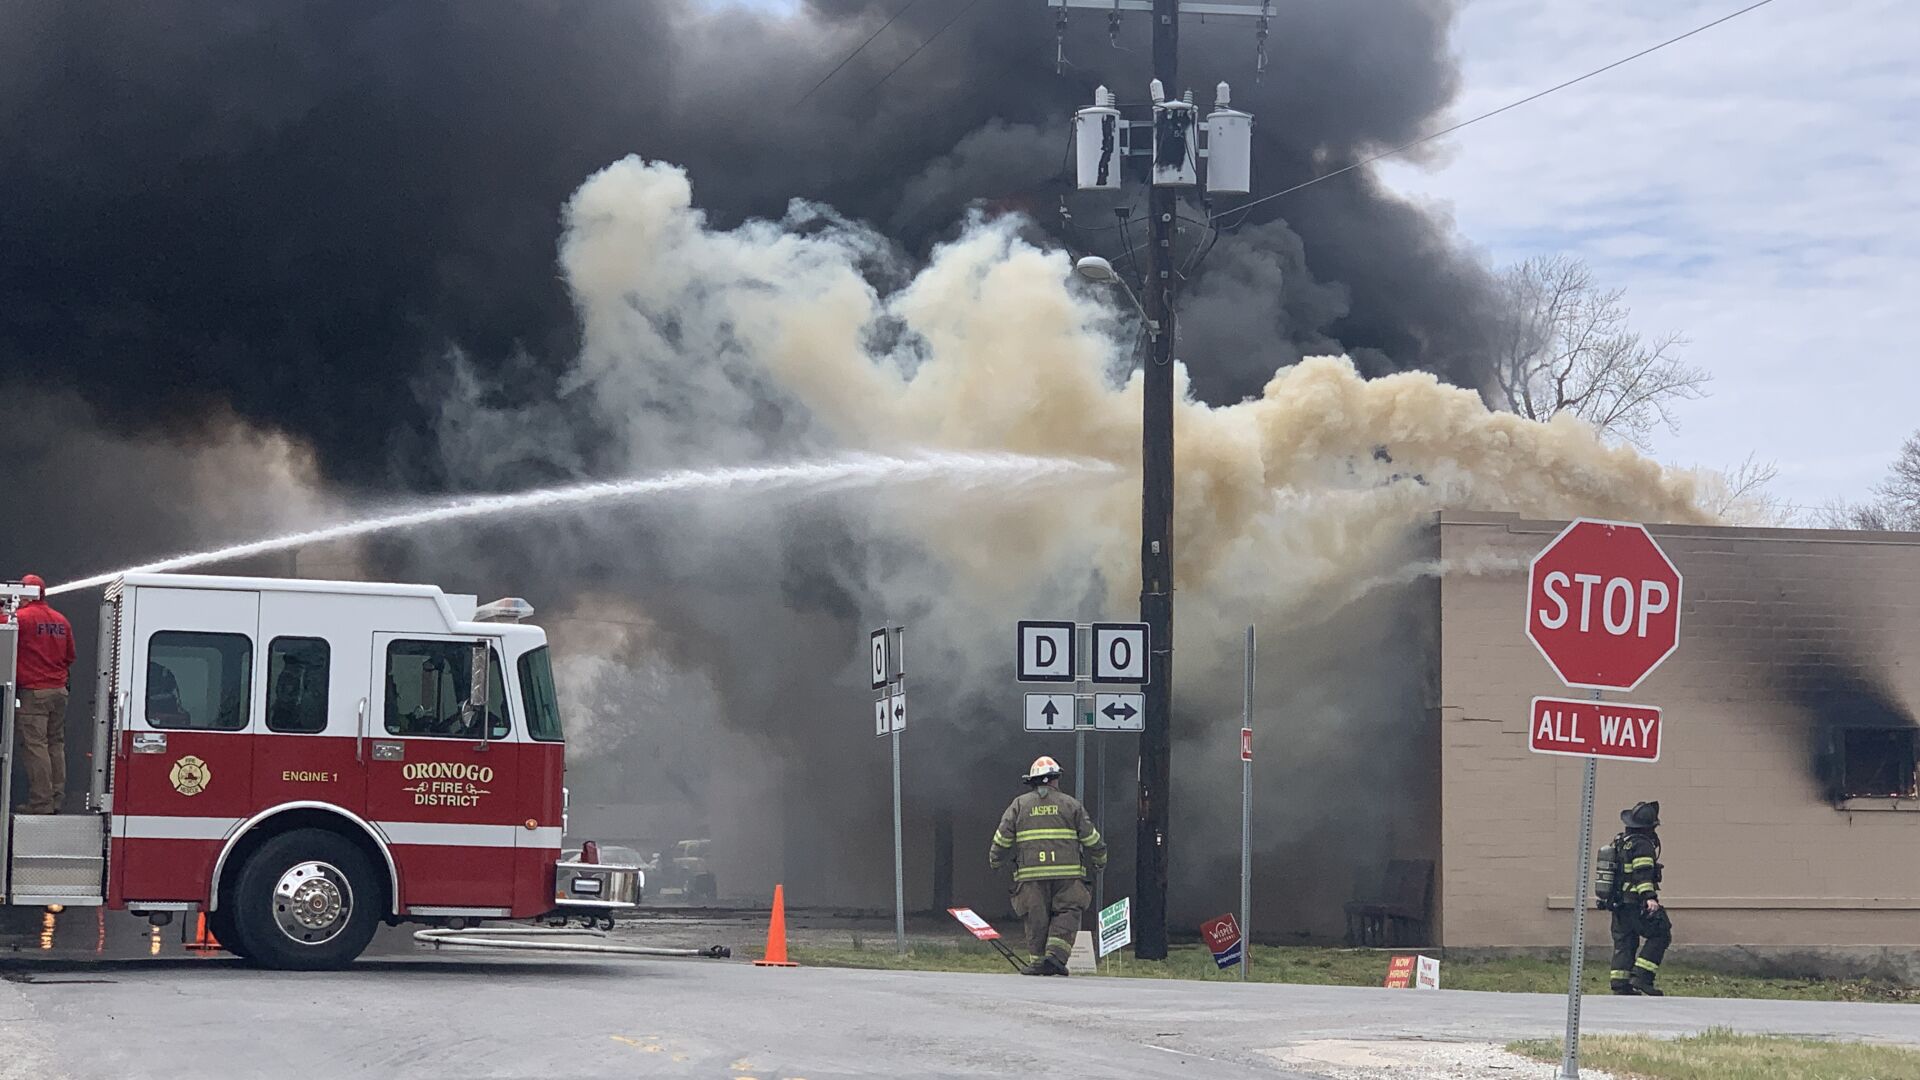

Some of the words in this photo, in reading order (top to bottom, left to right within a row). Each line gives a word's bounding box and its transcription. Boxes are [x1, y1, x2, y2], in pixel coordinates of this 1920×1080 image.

[1538, 571, 1670, 637] STOP
[38, 623, 65, 635] FIRE
[1036, 636, 1056, 667] D
[1537, 710, 1585, 743] ALL
[1600, 715, 1655, 748] WAY
[282, 771, 329, 782] ENGINE
[333, 772, 338, 782] 1
[402, 762, 493, 783] ORONOGO
[432, 781, 463, 793] FIRE
[415, 794, 479, 807] DISTRICT
[1030, 805, 1058, 817] JASPER
[1395, 958, 1410, 967] NOW
[1389, 969, 1410, 978] HIRING
